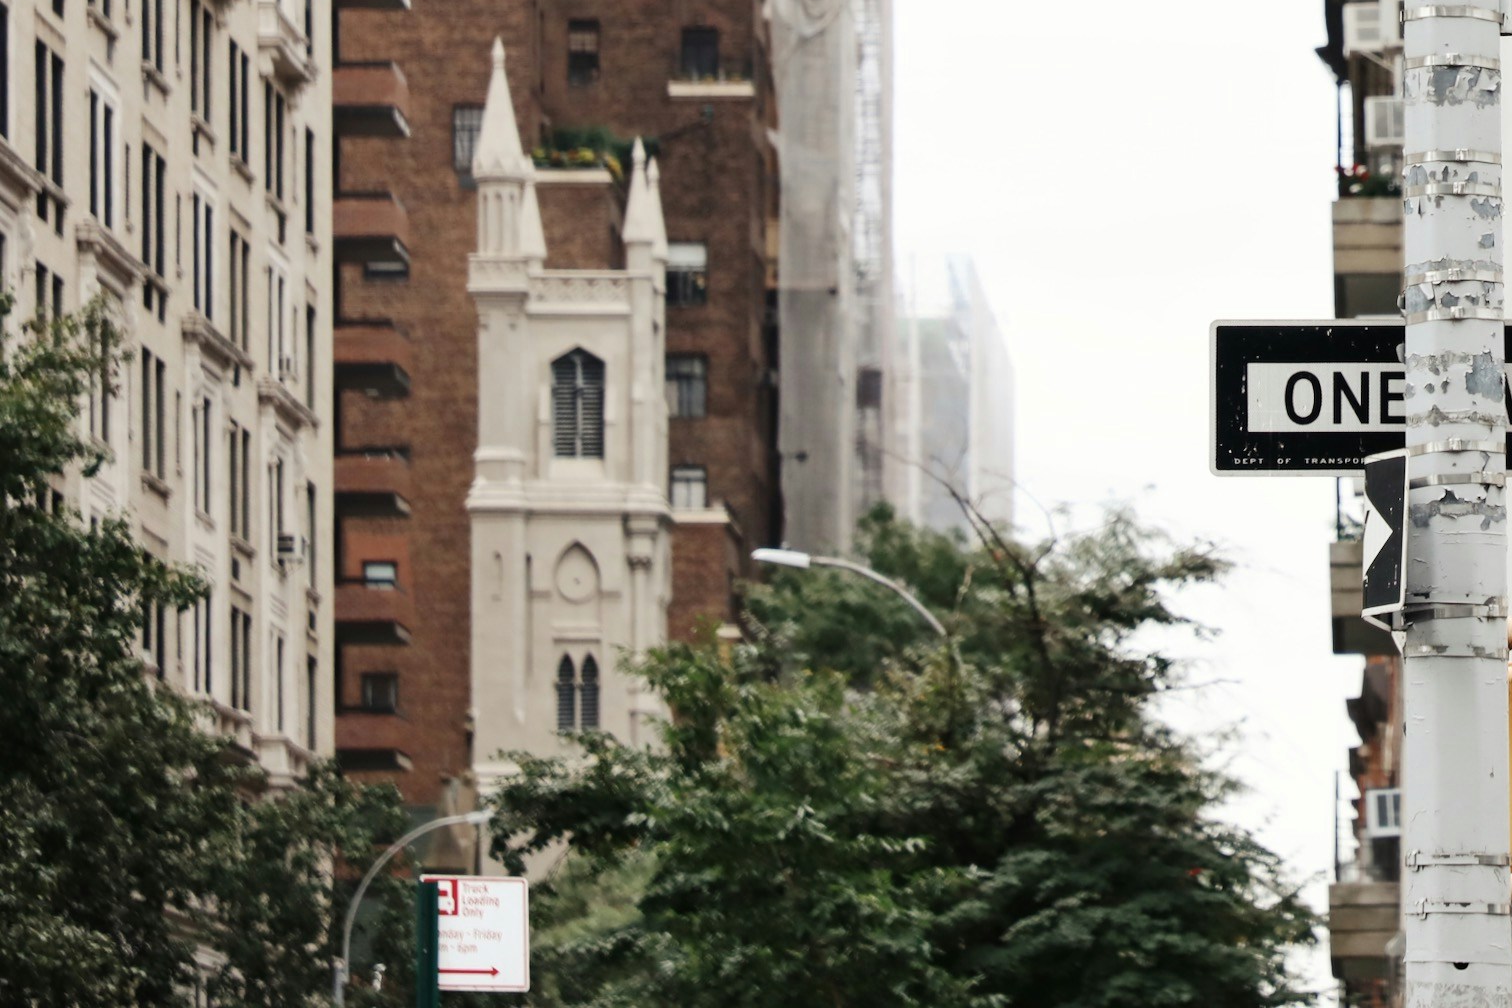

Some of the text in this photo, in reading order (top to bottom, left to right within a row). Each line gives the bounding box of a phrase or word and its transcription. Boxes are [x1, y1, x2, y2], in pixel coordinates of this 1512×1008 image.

[1284, 371, 1406, 425] ONE
[1233, 457, 1264, 465] DEPT
[1276, 457, 1291, 465] OF
[462, 882, 489, 894] Truck
[462, 895, 500, 908] Loading
[462, 907, 483, 919] Only
[473, 928, 503, 942] Friday
